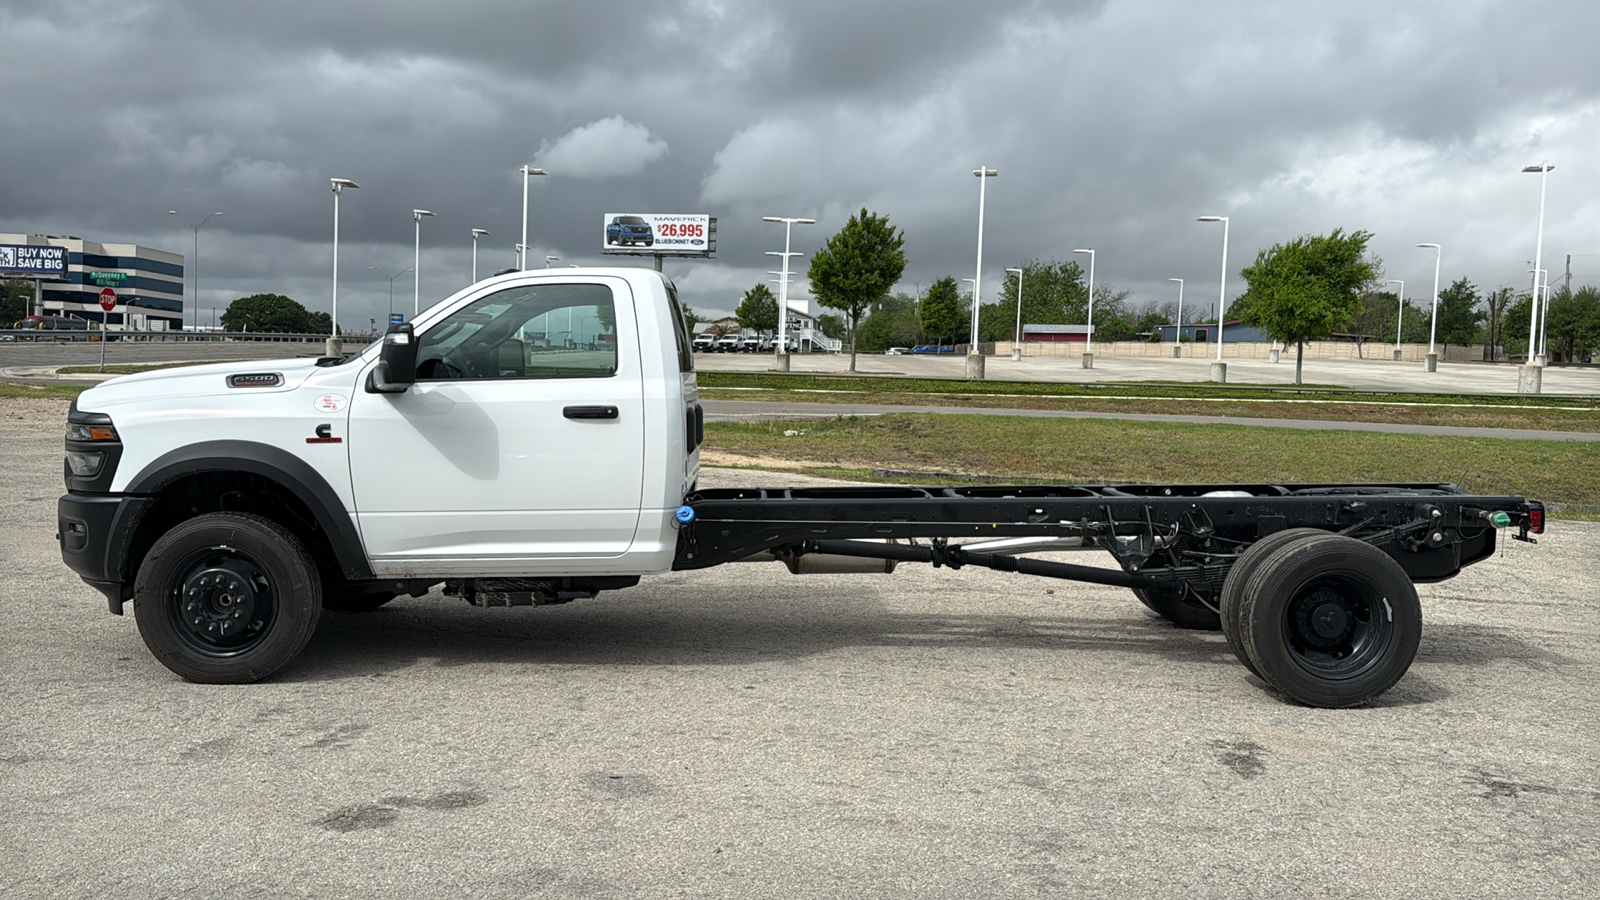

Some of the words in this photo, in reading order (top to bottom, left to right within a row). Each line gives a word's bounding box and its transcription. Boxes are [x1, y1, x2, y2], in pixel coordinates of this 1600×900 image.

[657, 224, 703, 238] $26,995
[18, 248, 38, 258] BUY
[40, 249, 63, 258] NOW
[18, 258, 42, 268] SAVE
[44, 260, 63, 269] BIG
[91, 271, 120, 279] McQueeney
[101, 294, 116, 304] STOP
